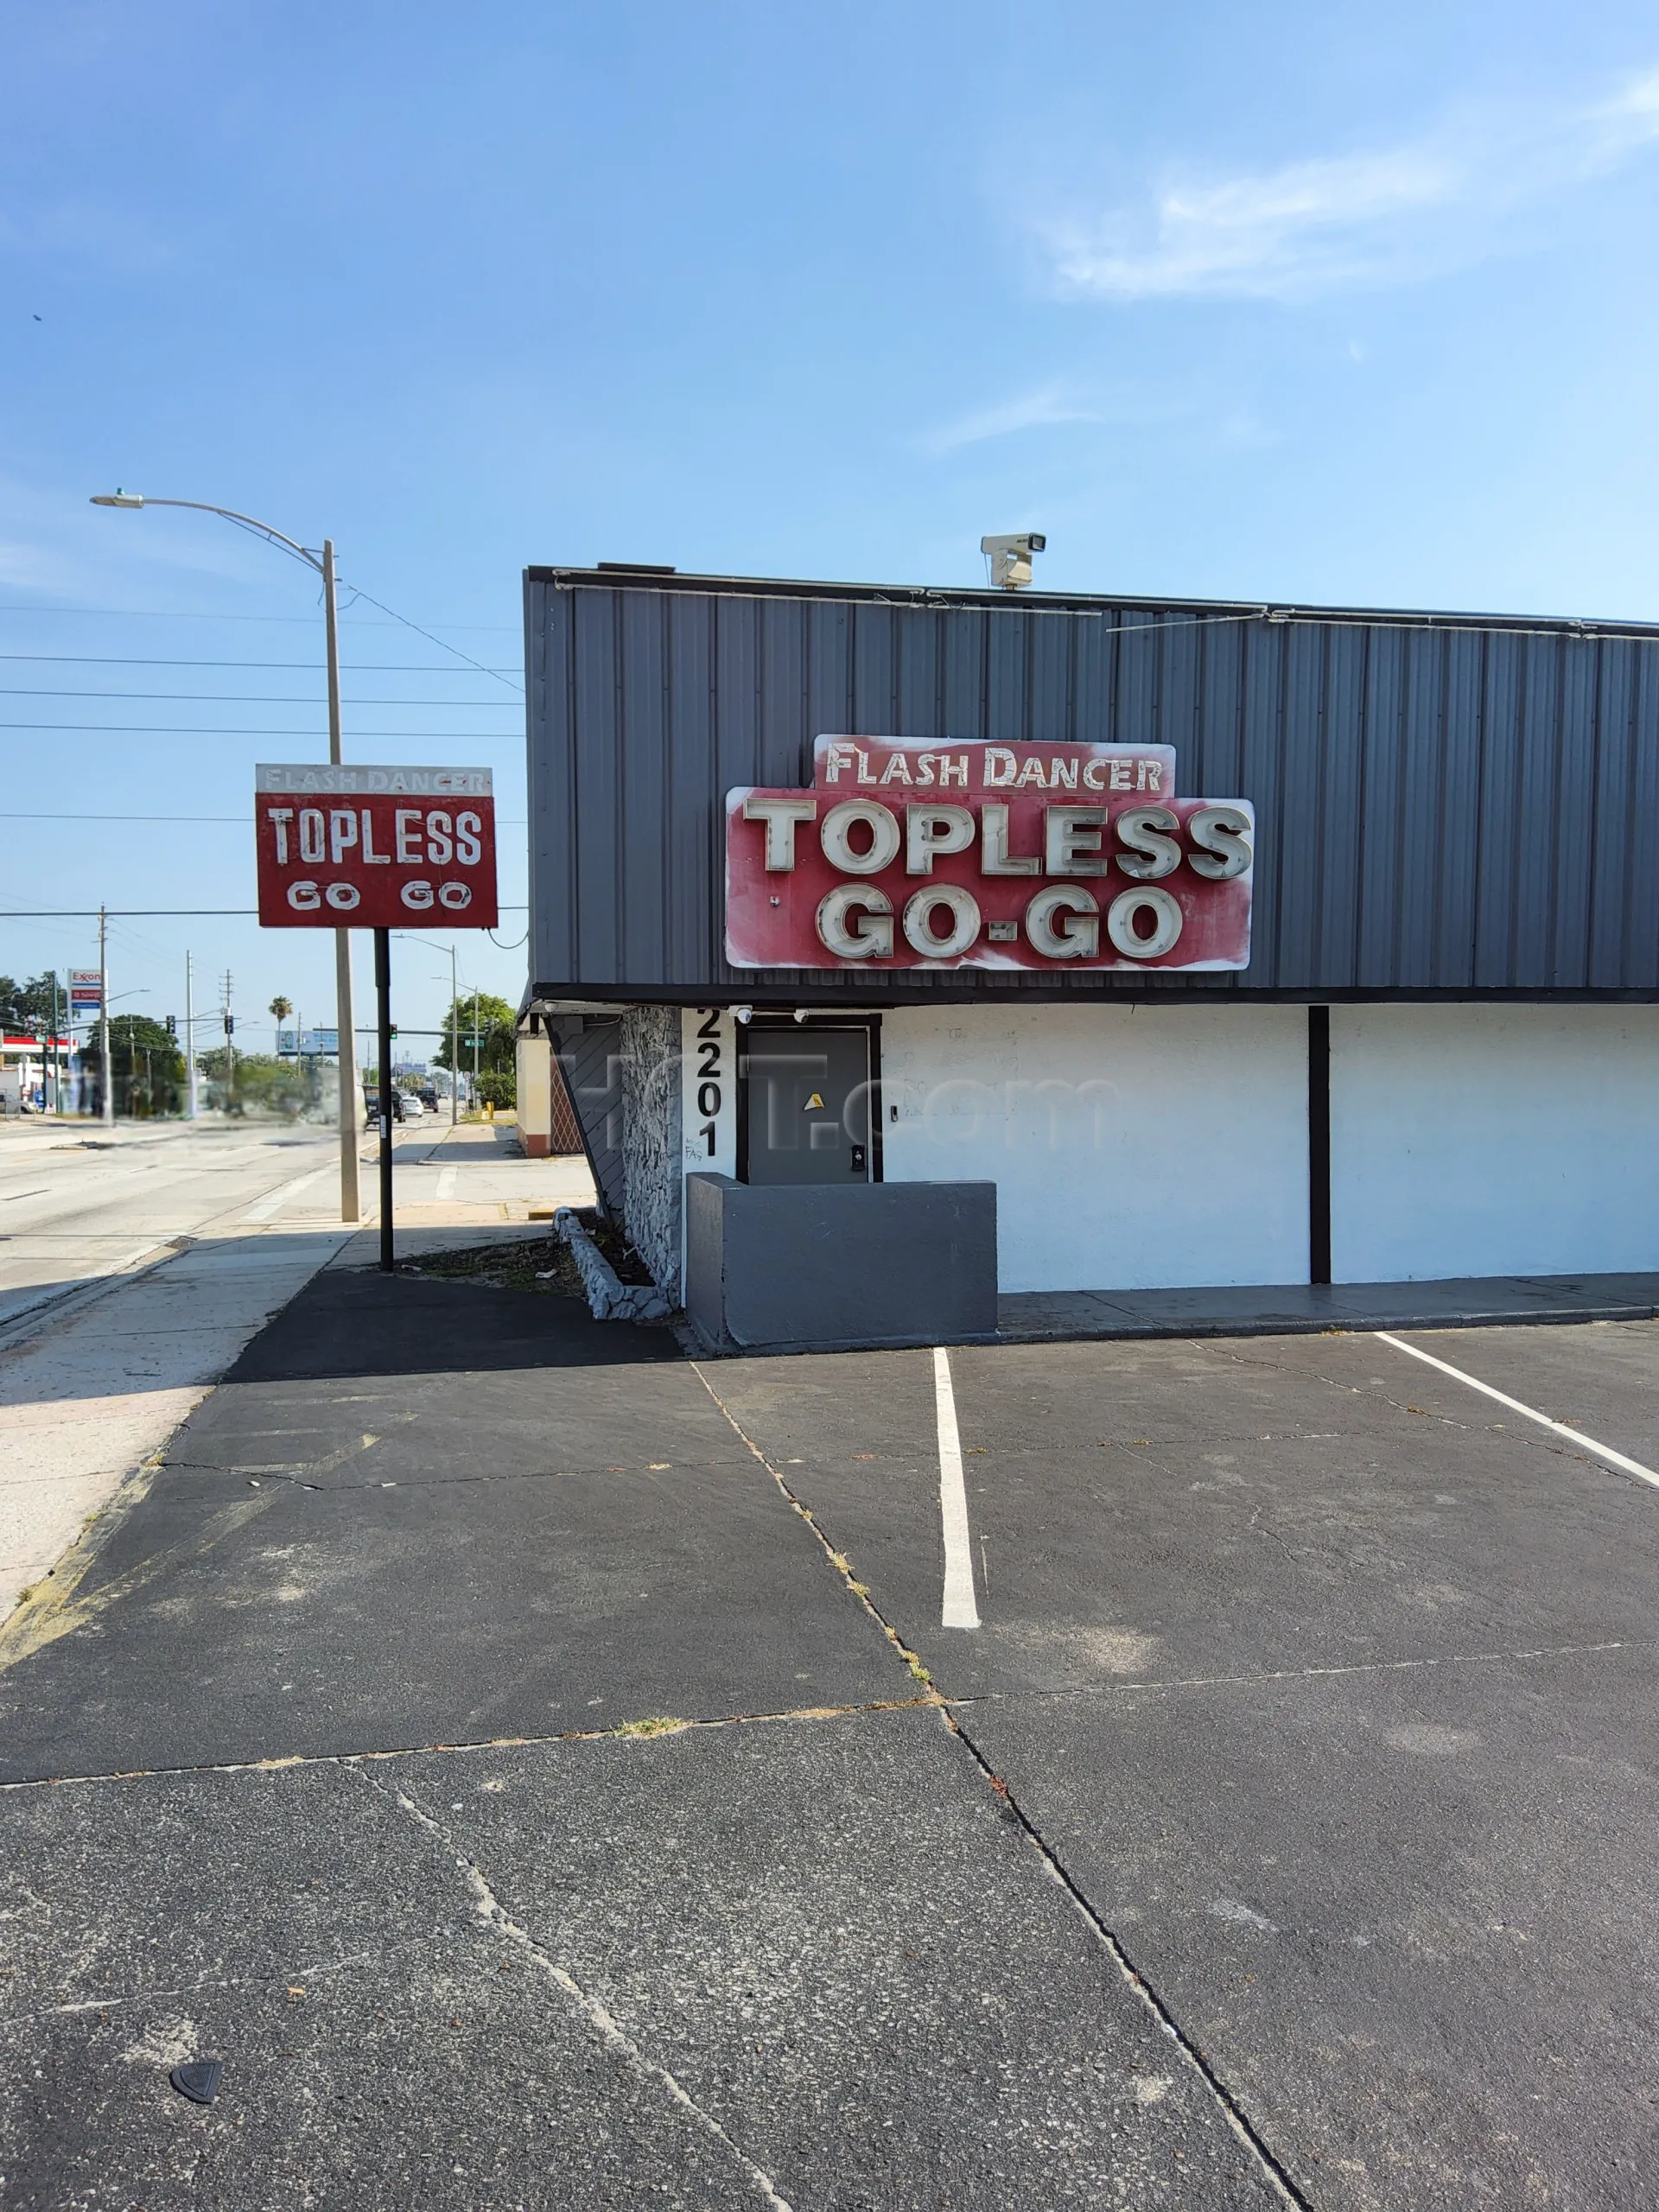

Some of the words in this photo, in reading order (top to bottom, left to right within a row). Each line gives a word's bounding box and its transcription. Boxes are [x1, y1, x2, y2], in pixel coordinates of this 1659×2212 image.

[264, 768, 357, 791] FLASH
[367, 770, 485, 793] DANCER
[824, 742, 969, 787] FLASH
[982, 747, 1164, 791] DANCER
[267, 807, 482, 866] TOPLESS
[743, 798, 1253, 880] TOPLESS
[287, 880, 361, 911] GO
[400, 880, 472, 910] GO
[815, 881, 1184, 960] GO-GO
[73, 972, 101, 982] Exxon
[696, 1009, 721, 1157] 2201
